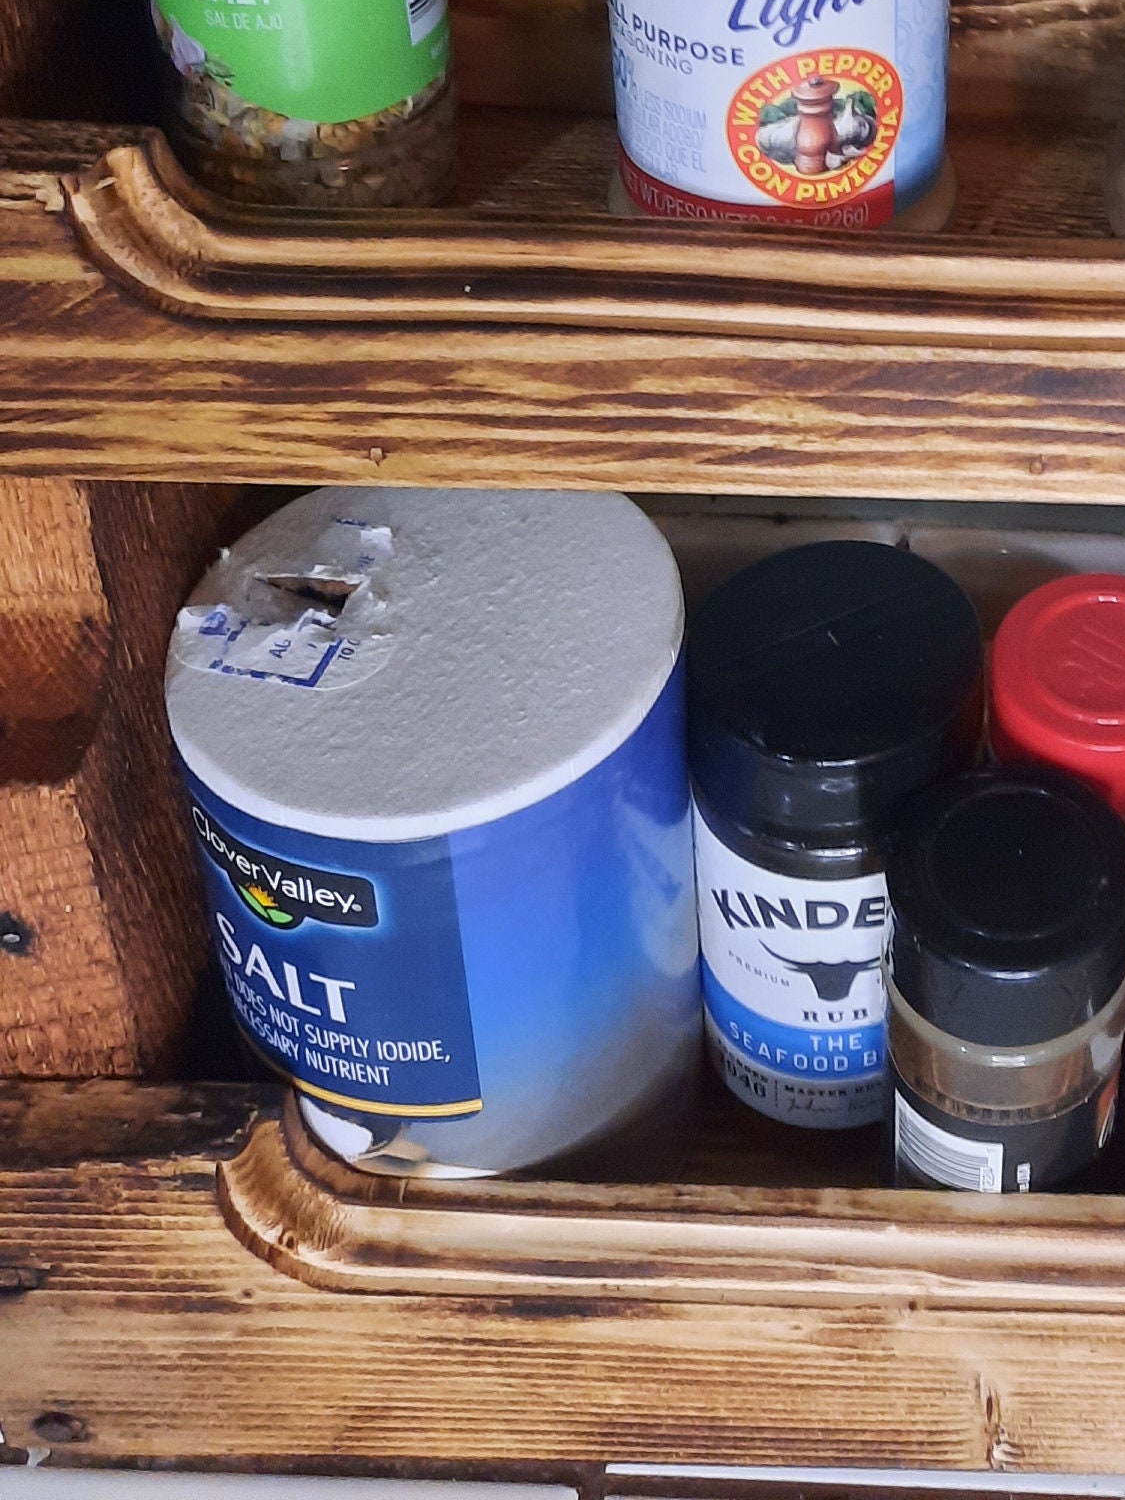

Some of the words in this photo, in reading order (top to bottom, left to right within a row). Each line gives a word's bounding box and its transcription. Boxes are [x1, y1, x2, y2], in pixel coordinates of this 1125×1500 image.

[632, 13, 746, 67] PURPOSE
[733, 67, 792, 127] WITH
[797, 52, 894, 98] PEPPER
[738, 144, 792, 196] CON
[795, 106, 900, 202] PIMIENTA
[215, 911, 357, 1024] SALT
[235, 975, 268, 1018] DOES
[269, 1005, 300, 1038] NOT
[303, 1023, 370, 1061] SUPPLY
[376, 1039, 452, 1064] IODIDE,
[801, 1007, 870, 1024] RUB
[809, 1032, 864, 1052] THE
[304, 1046, 391, 1088] NUTRIENT
[728, 1020, 849, 1073] SEAFOOD
